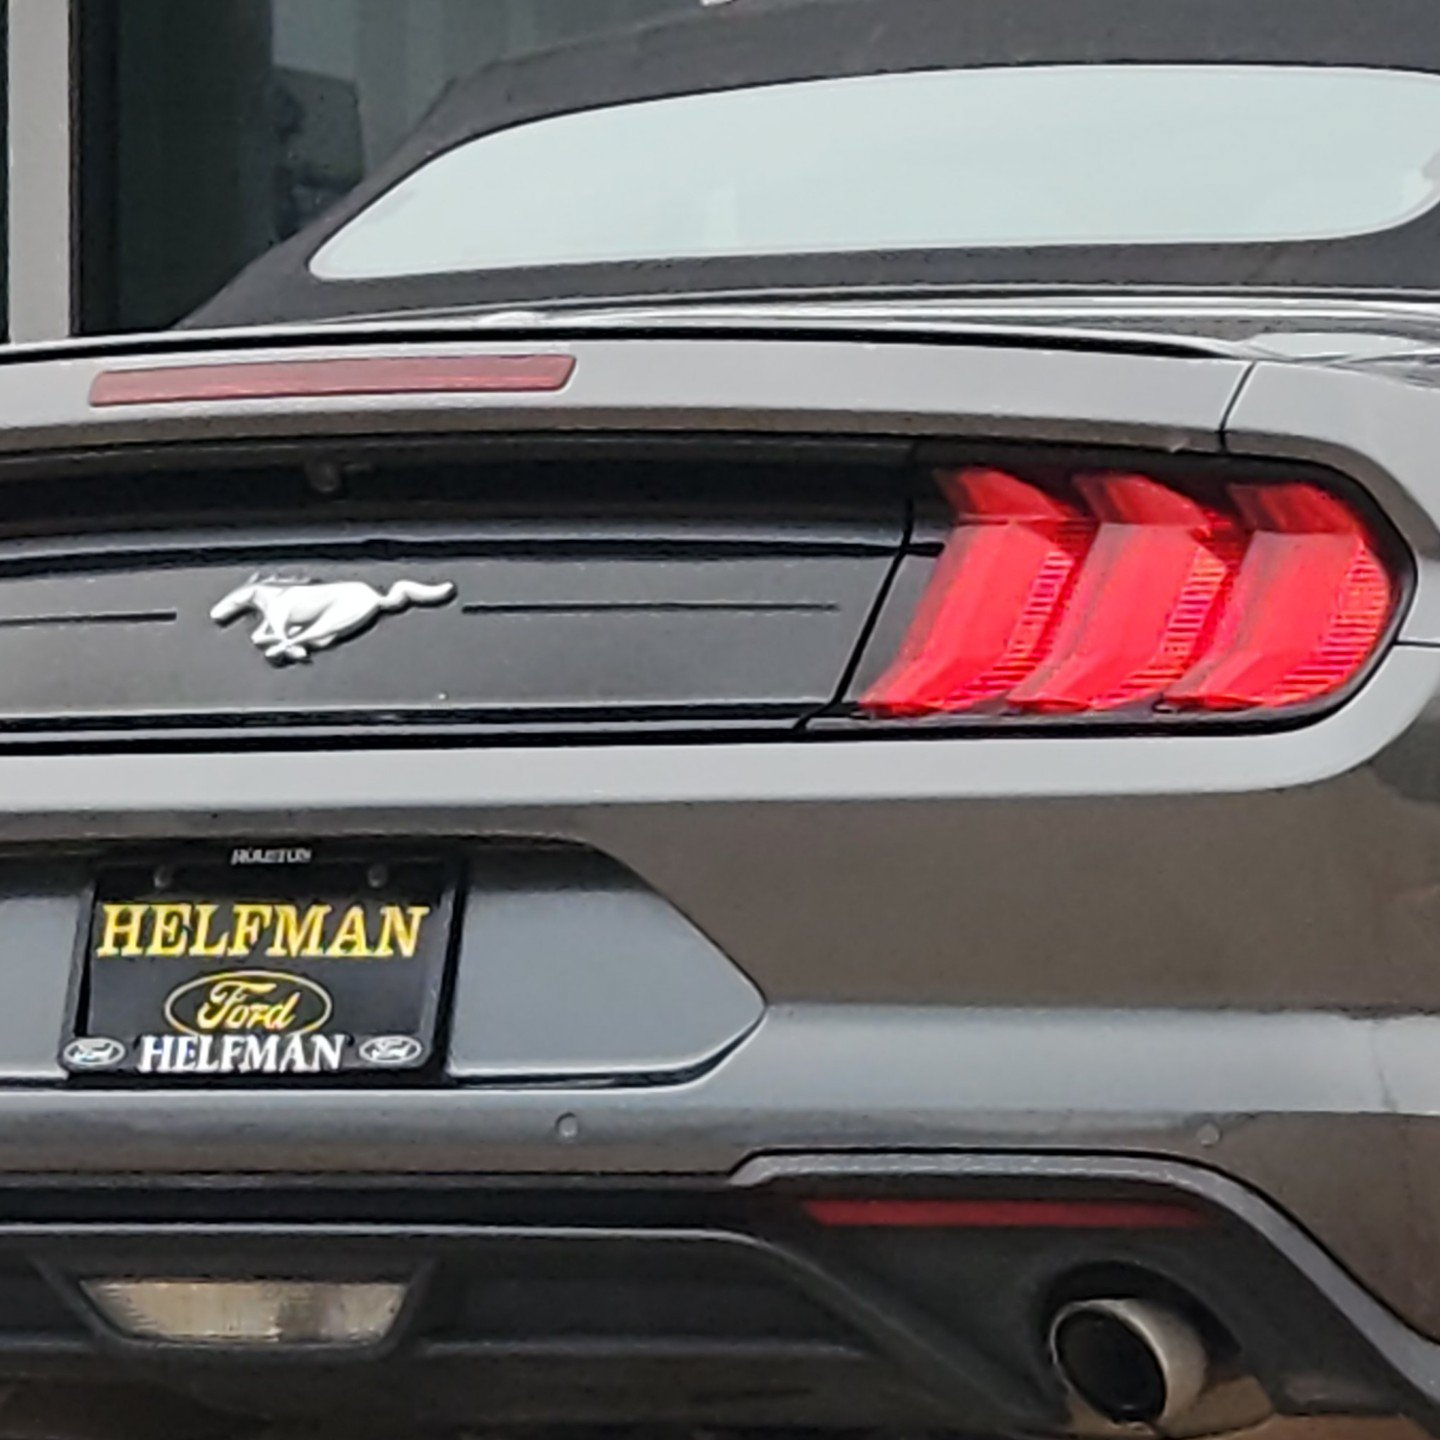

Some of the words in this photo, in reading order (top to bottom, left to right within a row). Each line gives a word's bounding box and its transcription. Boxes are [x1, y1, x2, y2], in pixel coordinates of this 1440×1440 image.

[96, 902, 430, 958] HELFMAN
[196, 980, 301, 1031] Ford
[137, 1033, 347, 1074] HELFMAN
